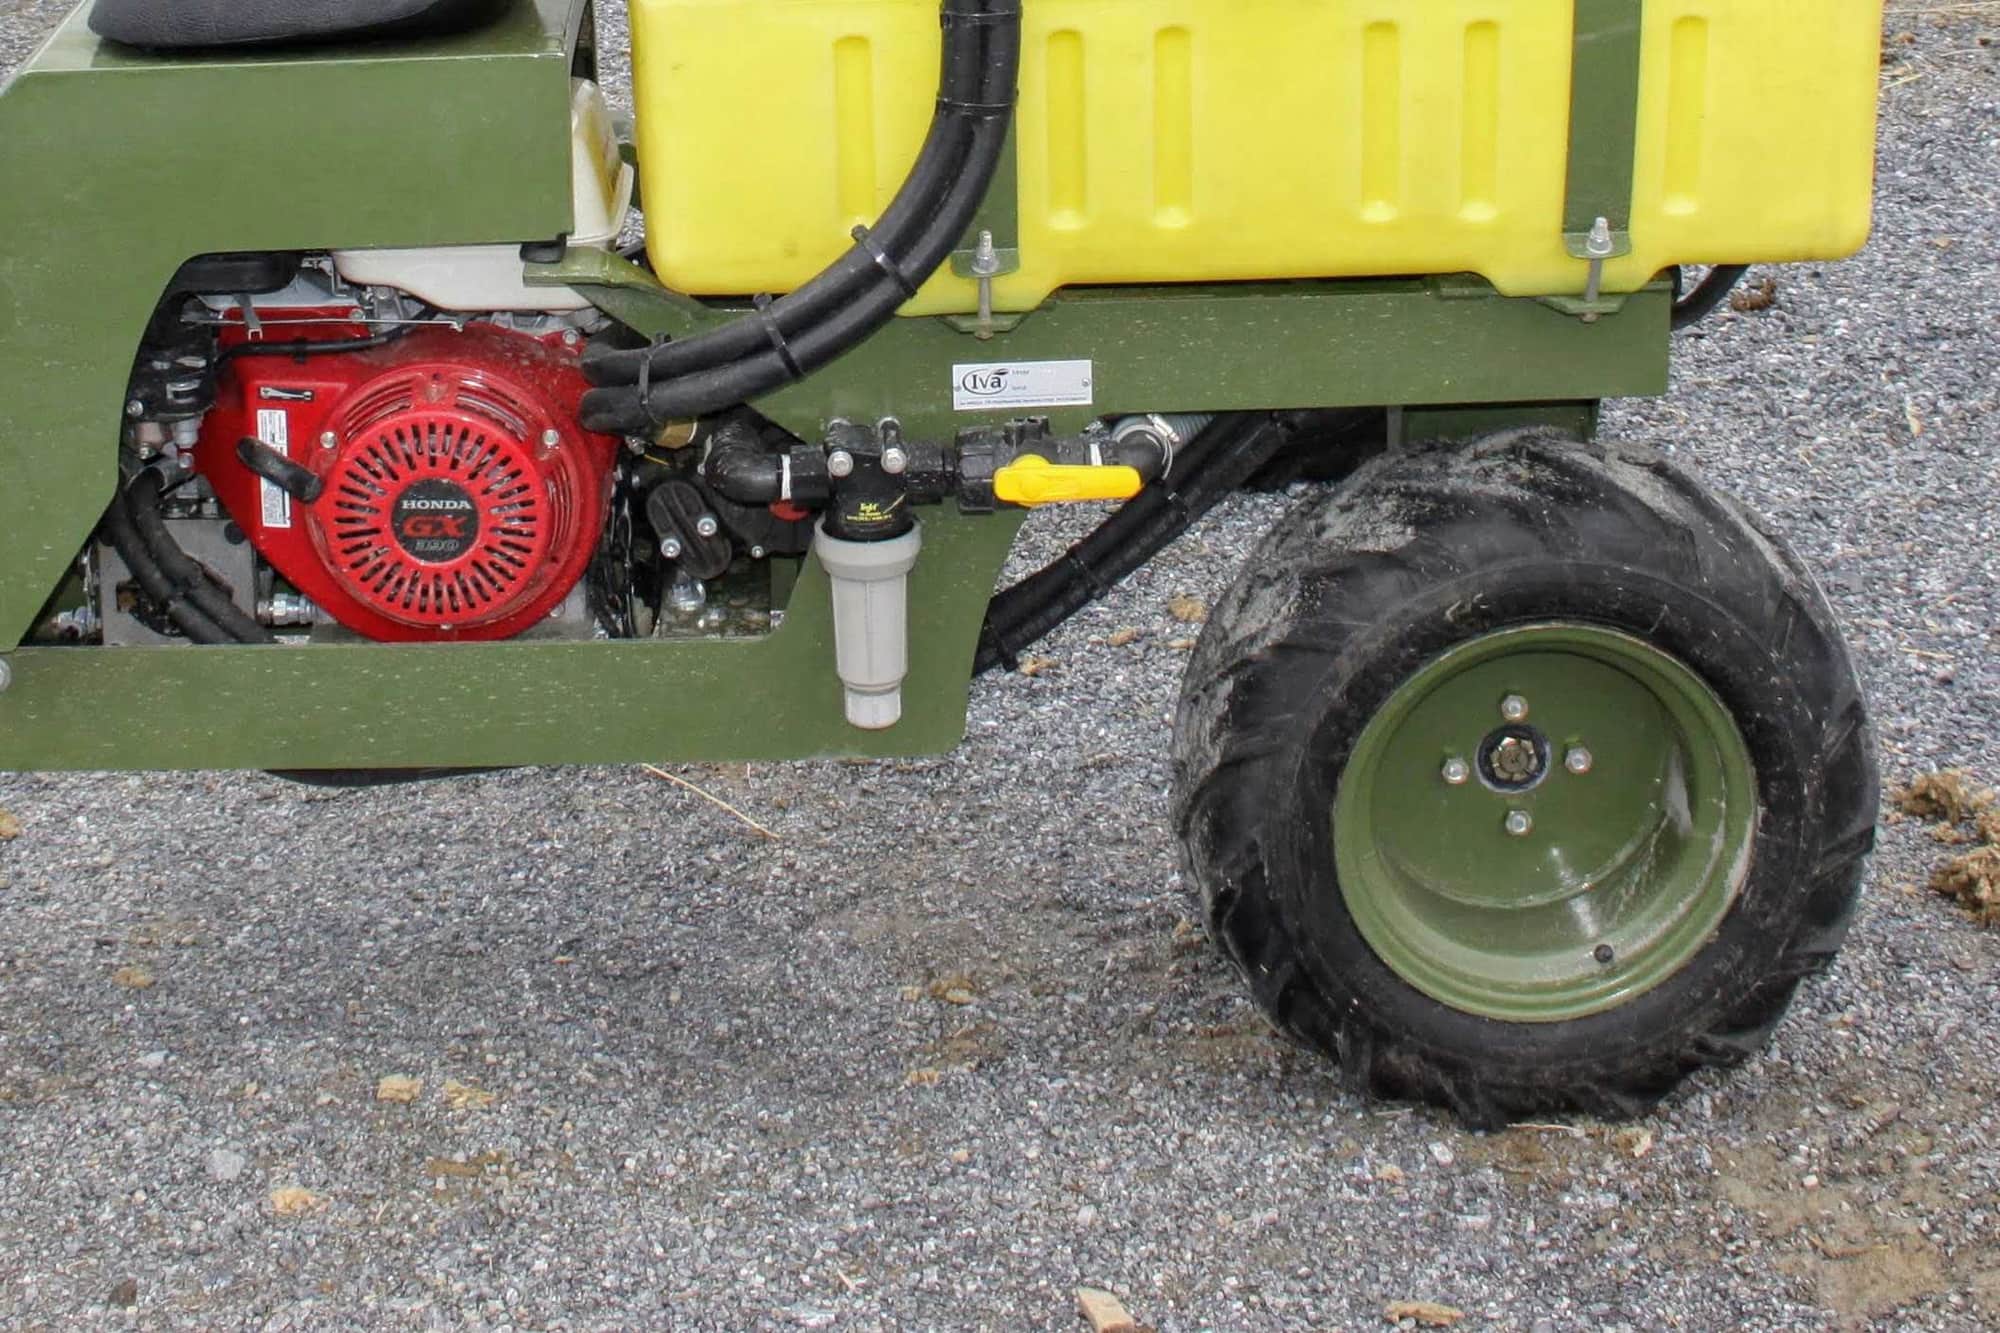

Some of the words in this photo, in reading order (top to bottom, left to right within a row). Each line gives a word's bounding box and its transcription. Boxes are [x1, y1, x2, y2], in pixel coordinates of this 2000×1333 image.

[971, 372, 1002, 390] Iva
[401, 499, 473, 510] HONDA
[403, 514, 468, 538] GX
